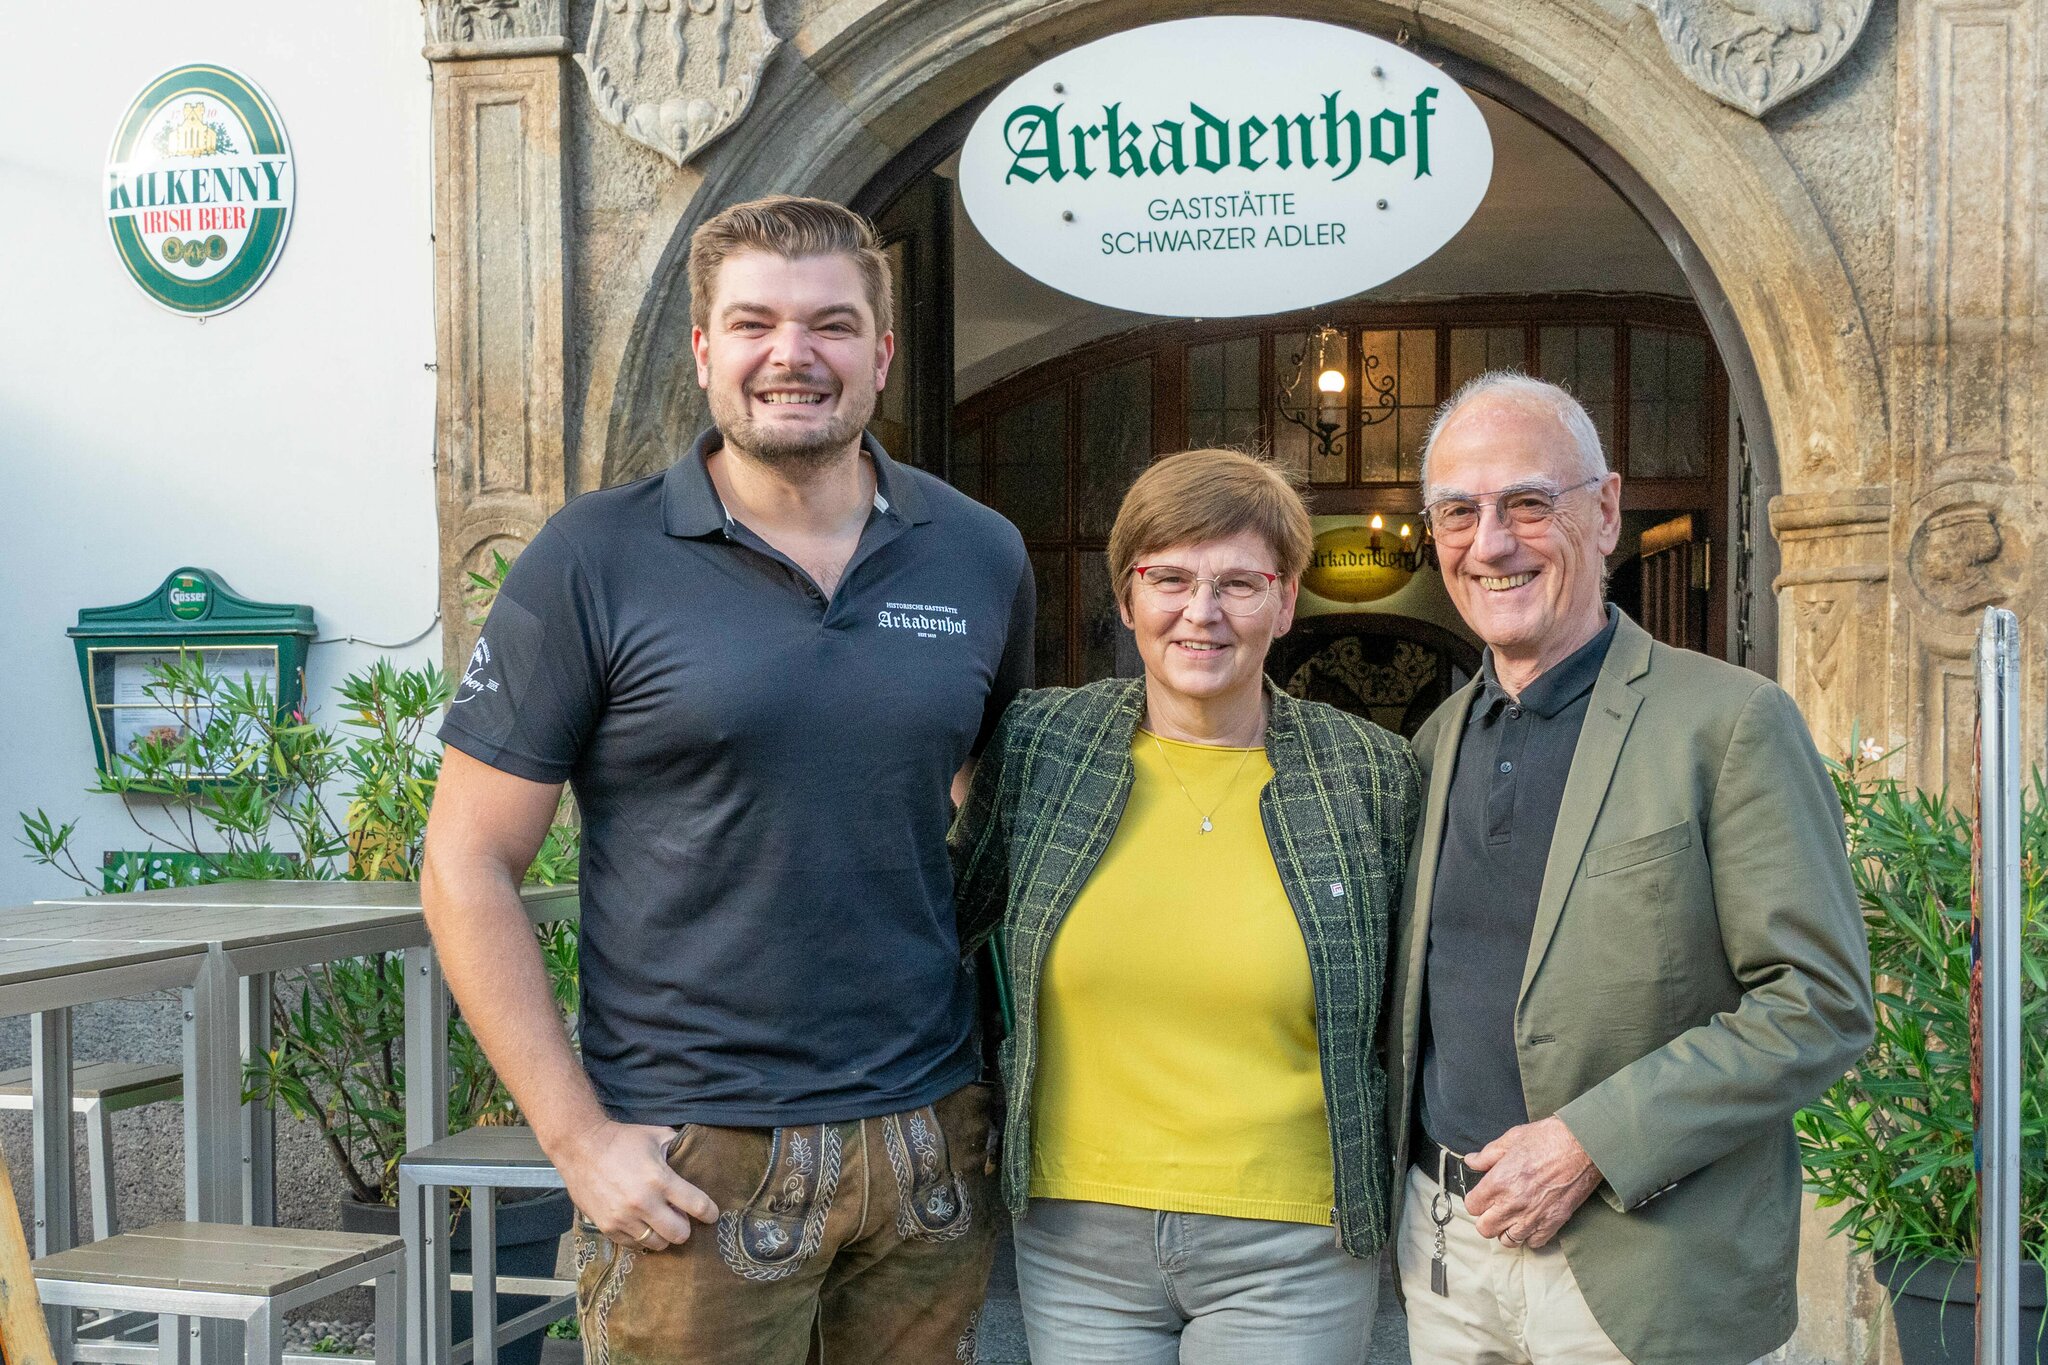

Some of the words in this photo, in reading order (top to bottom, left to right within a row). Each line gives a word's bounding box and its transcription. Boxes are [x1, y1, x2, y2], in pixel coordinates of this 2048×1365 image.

[1003, 87, 1440, 185] Arkadenhof
[109, 161, 287, 210] KILKENNY
[143, 211, 192, 234] IRISH
[199, 206, 247, 230] BEER
[1147, 191, 1296, 221] GASTSTÄTTE
[1101, 226, 1256, 255] SCHWARZER
[1264, 223, 1346, 248] ADLER
[170, 587, 206, 605] Gösser
[878, 611, 967, 635] Arkadenhof
